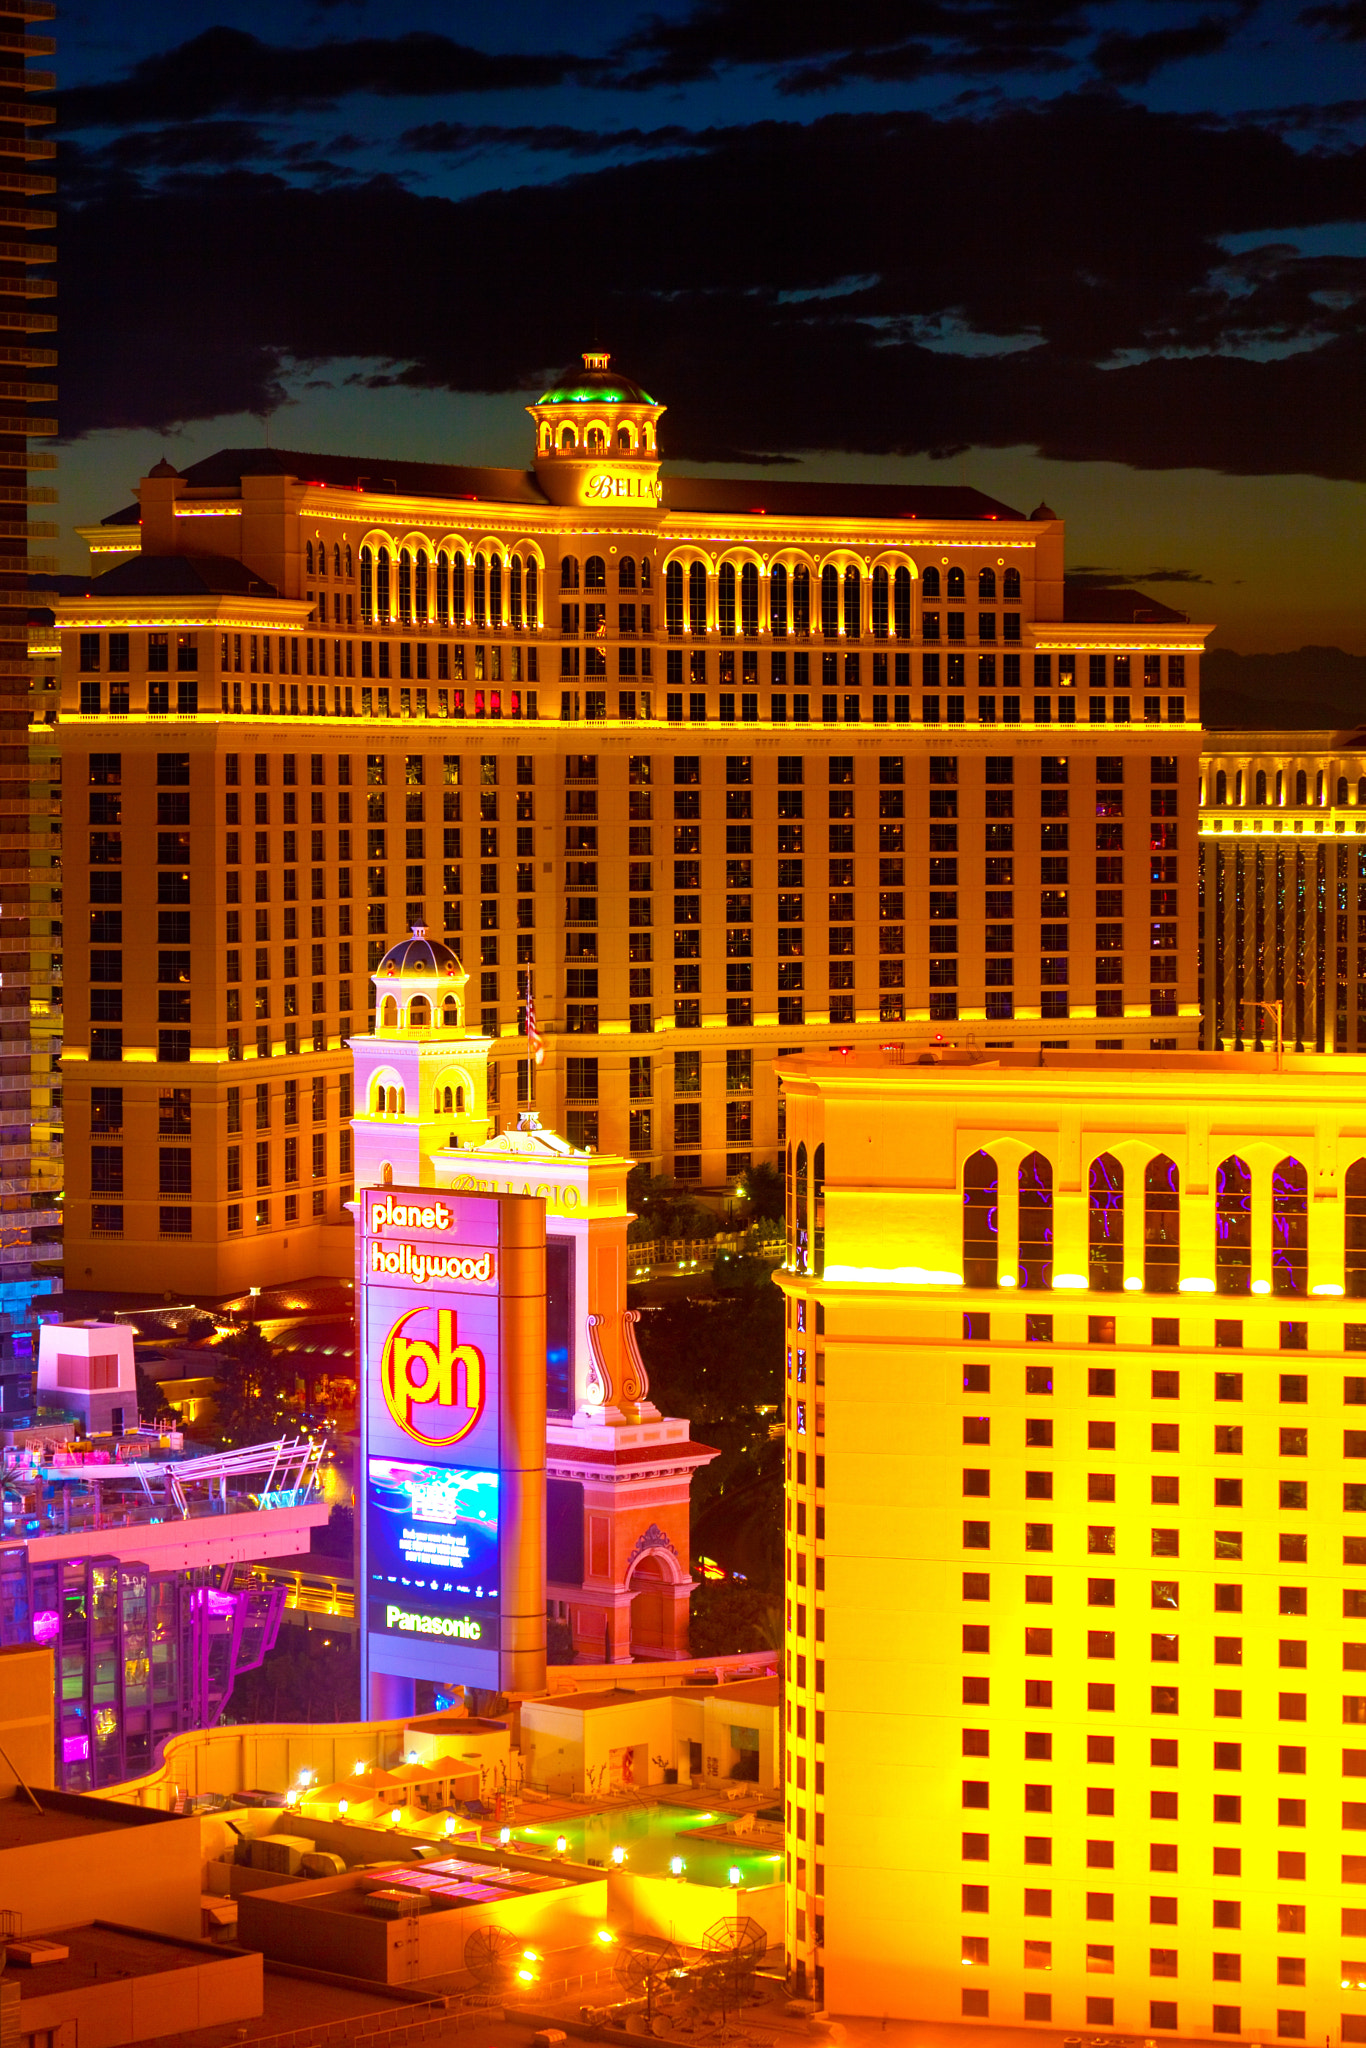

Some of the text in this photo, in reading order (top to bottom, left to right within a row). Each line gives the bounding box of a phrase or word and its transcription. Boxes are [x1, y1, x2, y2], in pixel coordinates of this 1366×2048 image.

[372, 1195, 452, 1234] planet
[372, 1241, 493, 1284] hollywood
[389, 1308, 485, 1424] ph
[386, 1605, 481, 1640] Panasonic
